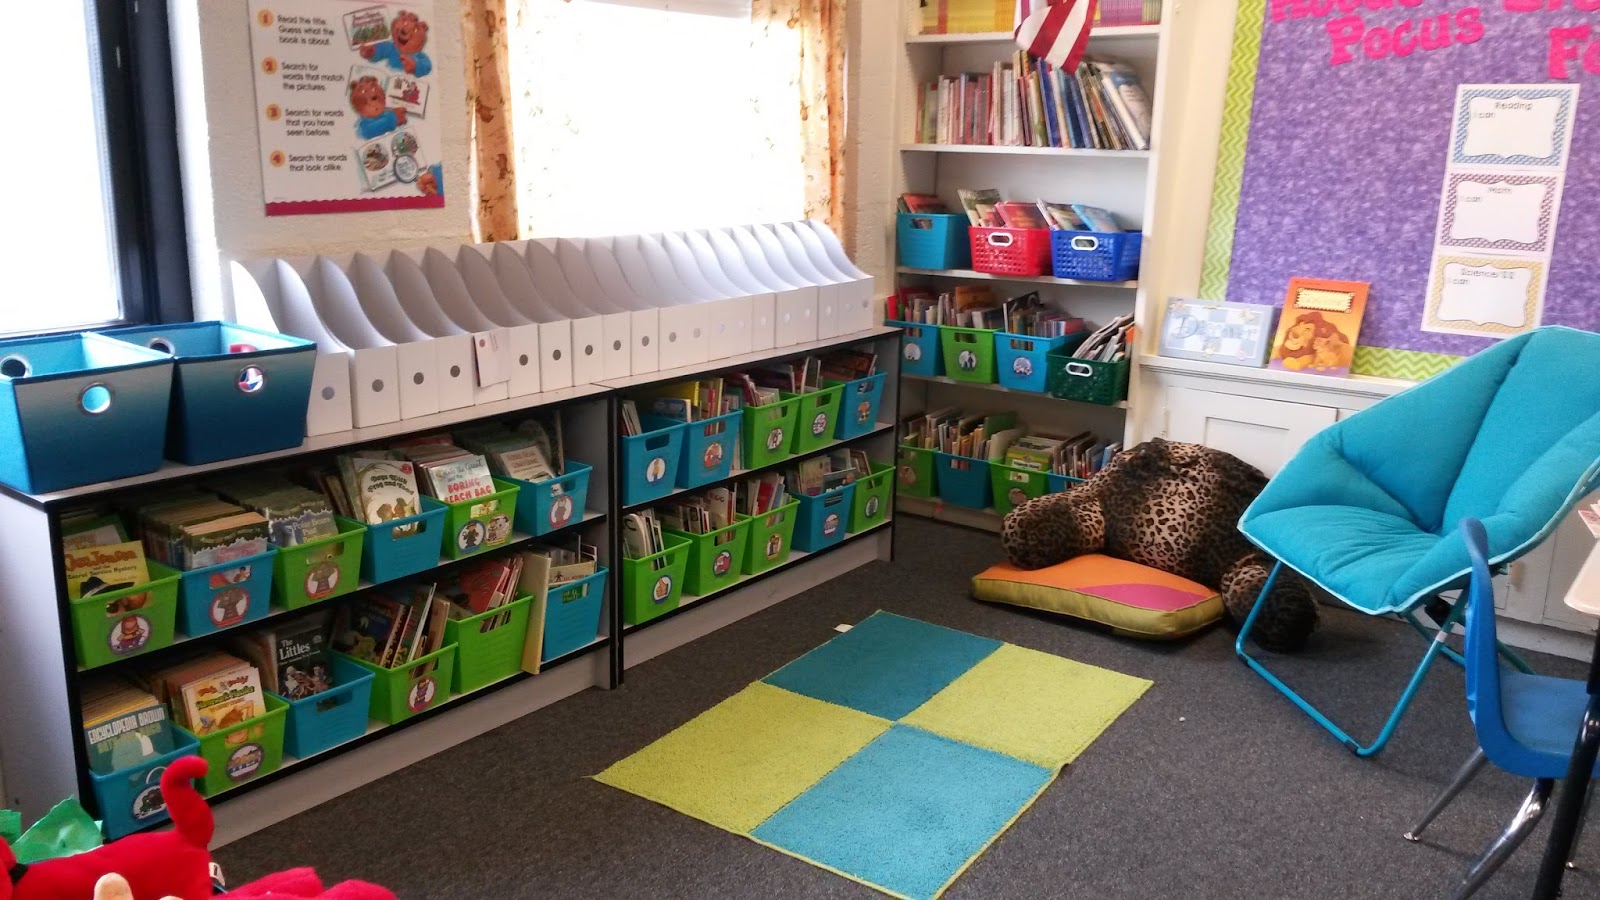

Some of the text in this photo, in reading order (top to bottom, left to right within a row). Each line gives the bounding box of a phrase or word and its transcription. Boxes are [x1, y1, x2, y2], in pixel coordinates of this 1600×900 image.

[277, 14, 298, 24] Read
[278, 25, 335, 36] Guess what the
[279, 36, 299, 44] book
[1325, 7, 1485, 66] Pocus
[281, 62, 307, 70] Search
[308, 63, 319, 71] for
[305, 73, 320, 81] that
[283, 82, 295, 90] the
[1495, 101, 1533, 111] Reading
[285, 108, 311, 116] Search
[288, 154, 315, 162] Search
[315, 154, 326, 162] for
[327, 154, 348, 162] words
[447, 476, 481, 493] BORING
[444, 485, 492, 503] BEACH BAG
[281, 639, 293, 647] The
[279, 643, 310, 660] Littles
[88, 707, 165, 745] ENCYCLOPEDIA BROWN
